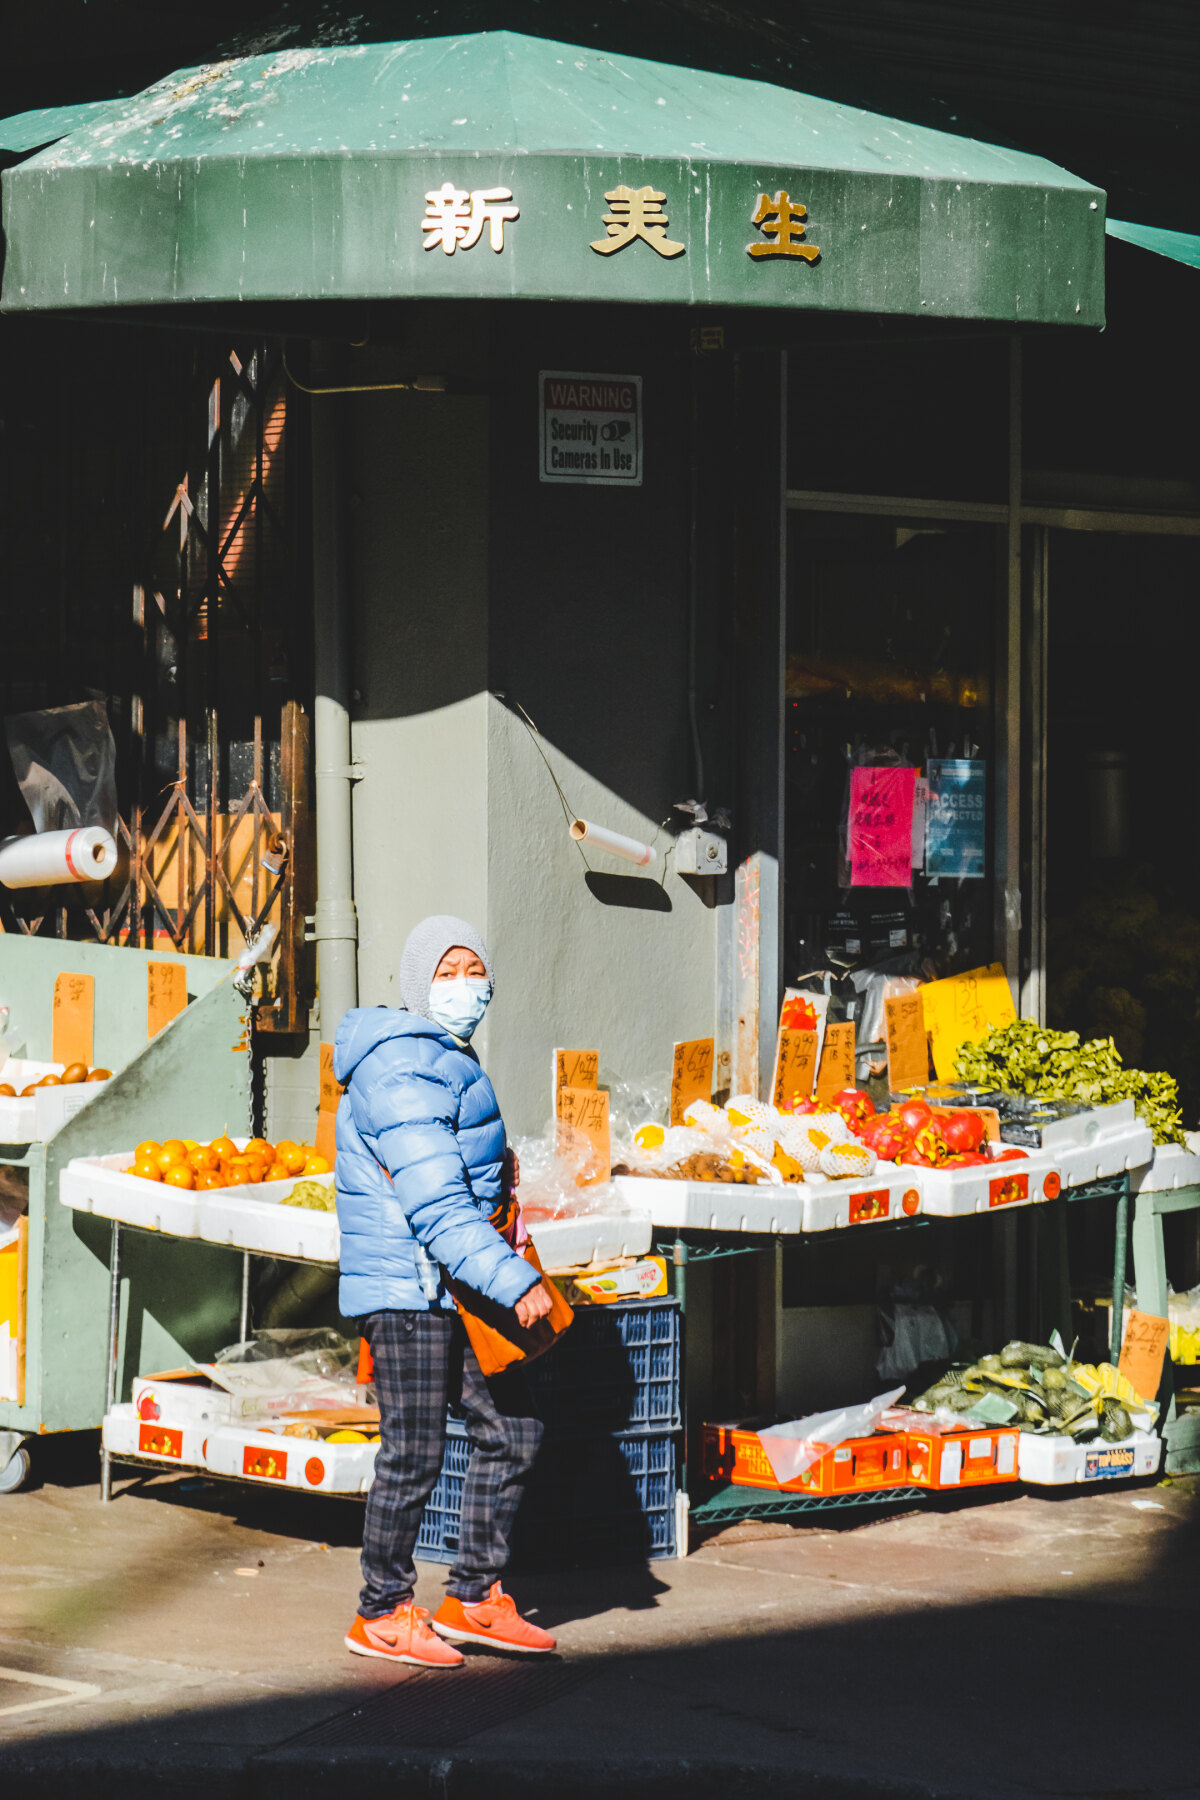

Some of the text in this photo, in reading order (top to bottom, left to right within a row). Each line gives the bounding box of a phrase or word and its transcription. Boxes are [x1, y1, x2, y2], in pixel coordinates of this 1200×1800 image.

[550, 383, 633, 409] WARNING
[551, 418, 598, 446] Security
[551, 446, 633, 470] Cameras In Use
[930, 793, 983, 809] ACCESS
